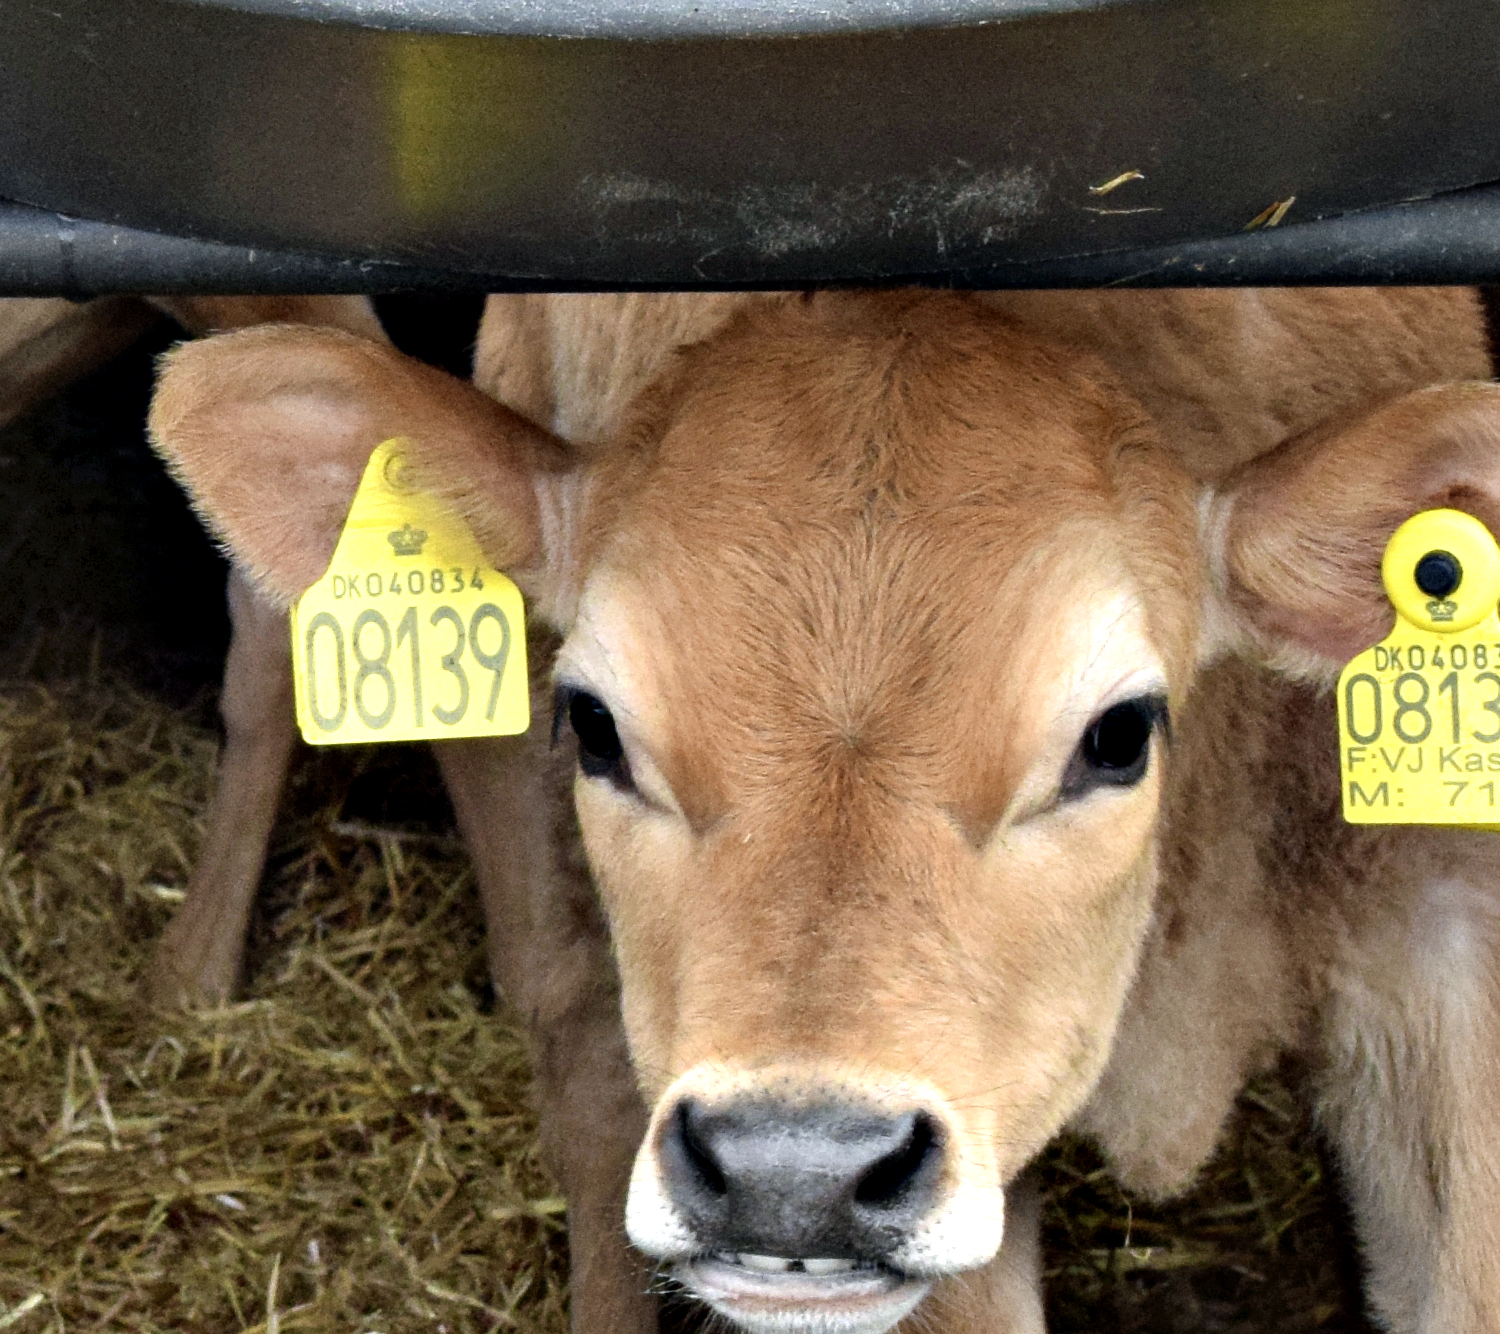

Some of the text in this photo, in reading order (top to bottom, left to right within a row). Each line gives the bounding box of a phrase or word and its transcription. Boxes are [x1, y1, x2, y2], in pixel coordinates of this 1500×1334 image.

[333, 567, 485, 599] DK040834
[305, 602, 512, 733] 08139
[1349, 781, 1404, 807] M:
